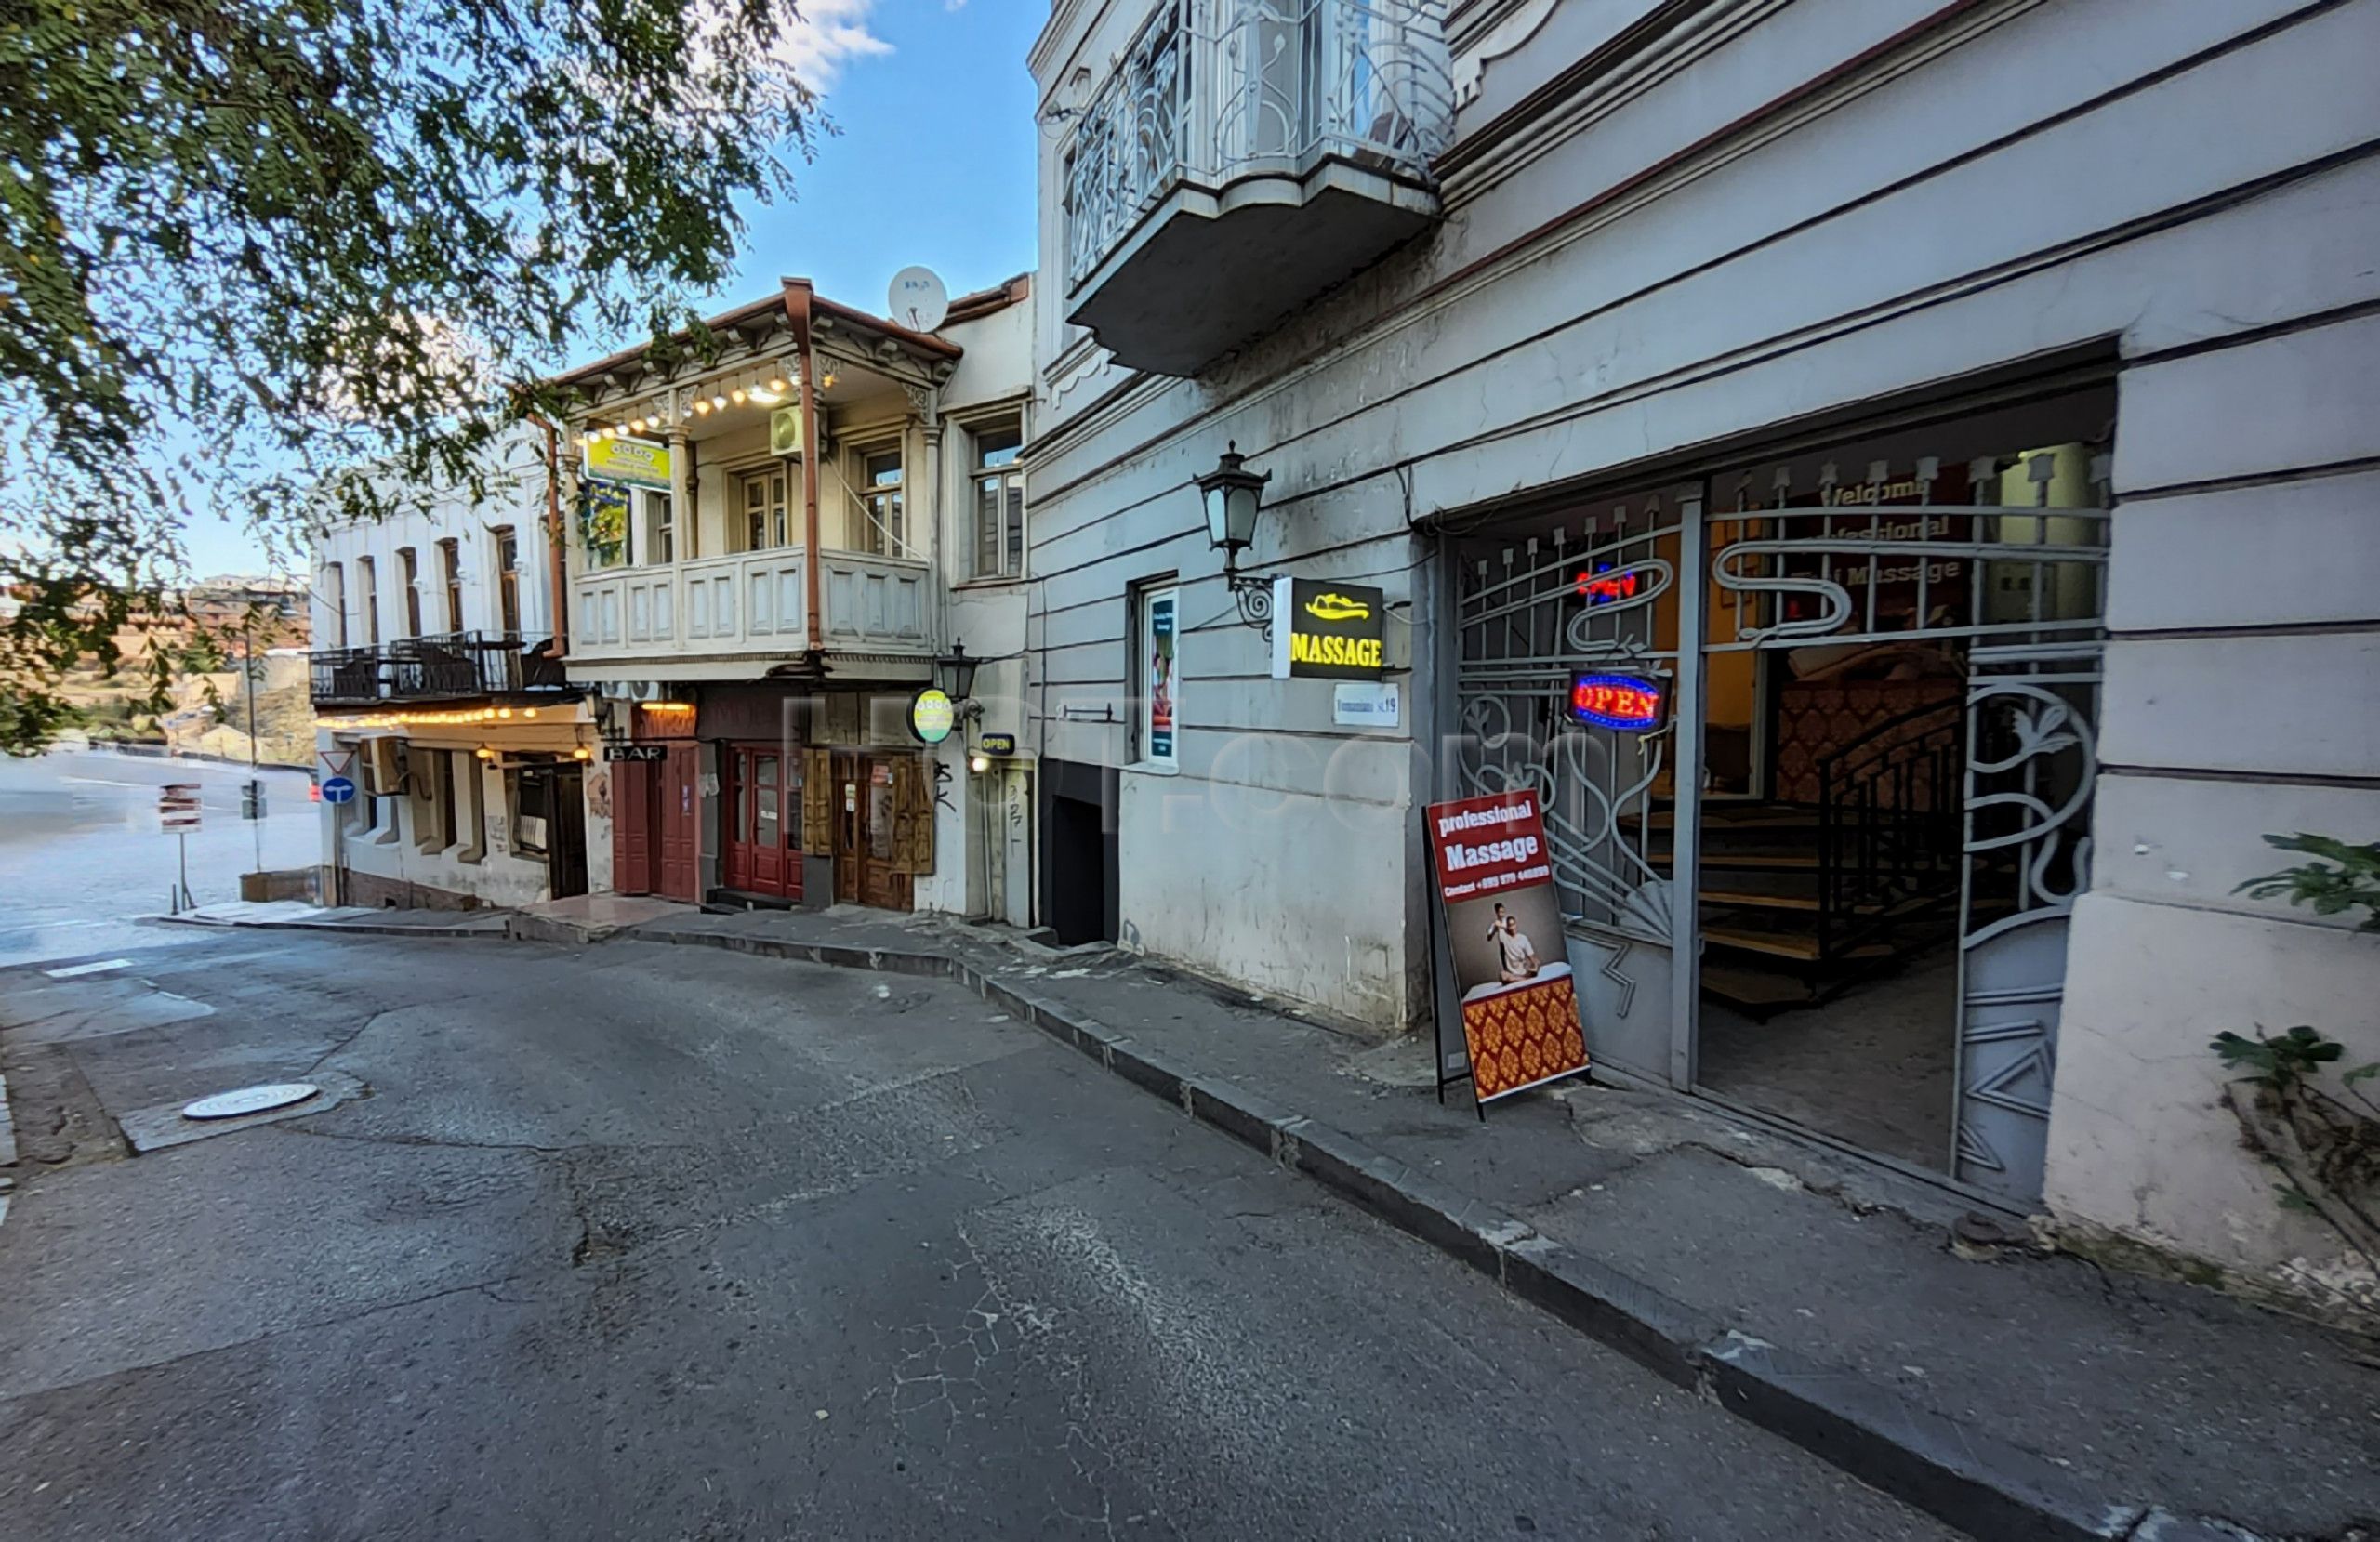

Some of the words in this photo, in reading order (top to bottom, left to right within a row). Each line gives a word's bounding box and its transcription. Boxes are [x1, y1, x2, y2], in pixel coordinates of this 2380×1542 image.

[1290, 632, 1382, 667] MASSAGE
[1573, 683, 1659, 718] OPEN
[609, 747, 662, 760] BAR
[982, 738, 1011, 751] OPEN
[1438, 799, 1533, 837] professional
[1444, 836, 1539, 872] Massage
